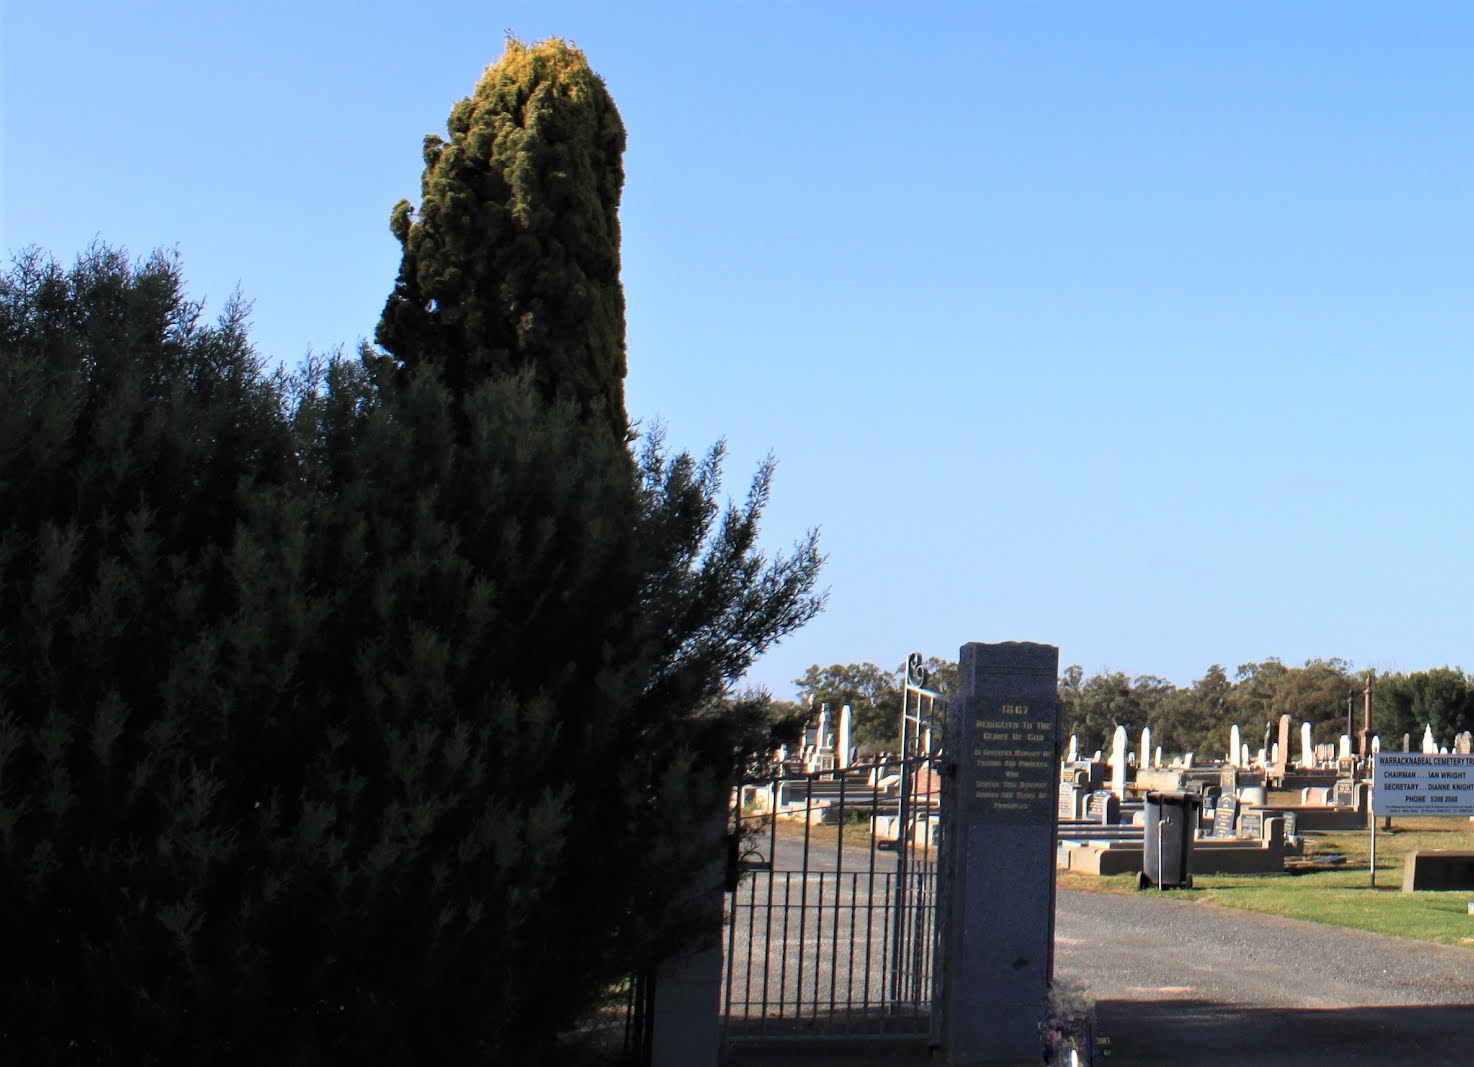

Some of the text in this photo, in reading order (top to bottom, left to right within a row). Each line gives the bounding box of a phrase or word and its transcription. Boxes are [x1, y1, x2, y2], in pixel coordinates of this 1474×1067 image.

[1002, 705, 1029, 715] 1867
[1380, 756, 1432, 766] WARRACKNABEAL
[1434, 757, 1465, 766] CEMETERY
[1384, 771, 1416, 779] CHAIRMAN
[1428, 771, 1439, 779] IAN
[1441, 771, 1466, 779] WRIGHT
[1384, 783, 1419, 791] SECRETARY
[1428, 783, 1450, 791] DIANNE
[1452, 783, 1474, 791] KNIGHT
[1405, 795, 1426, 803] PHONE
